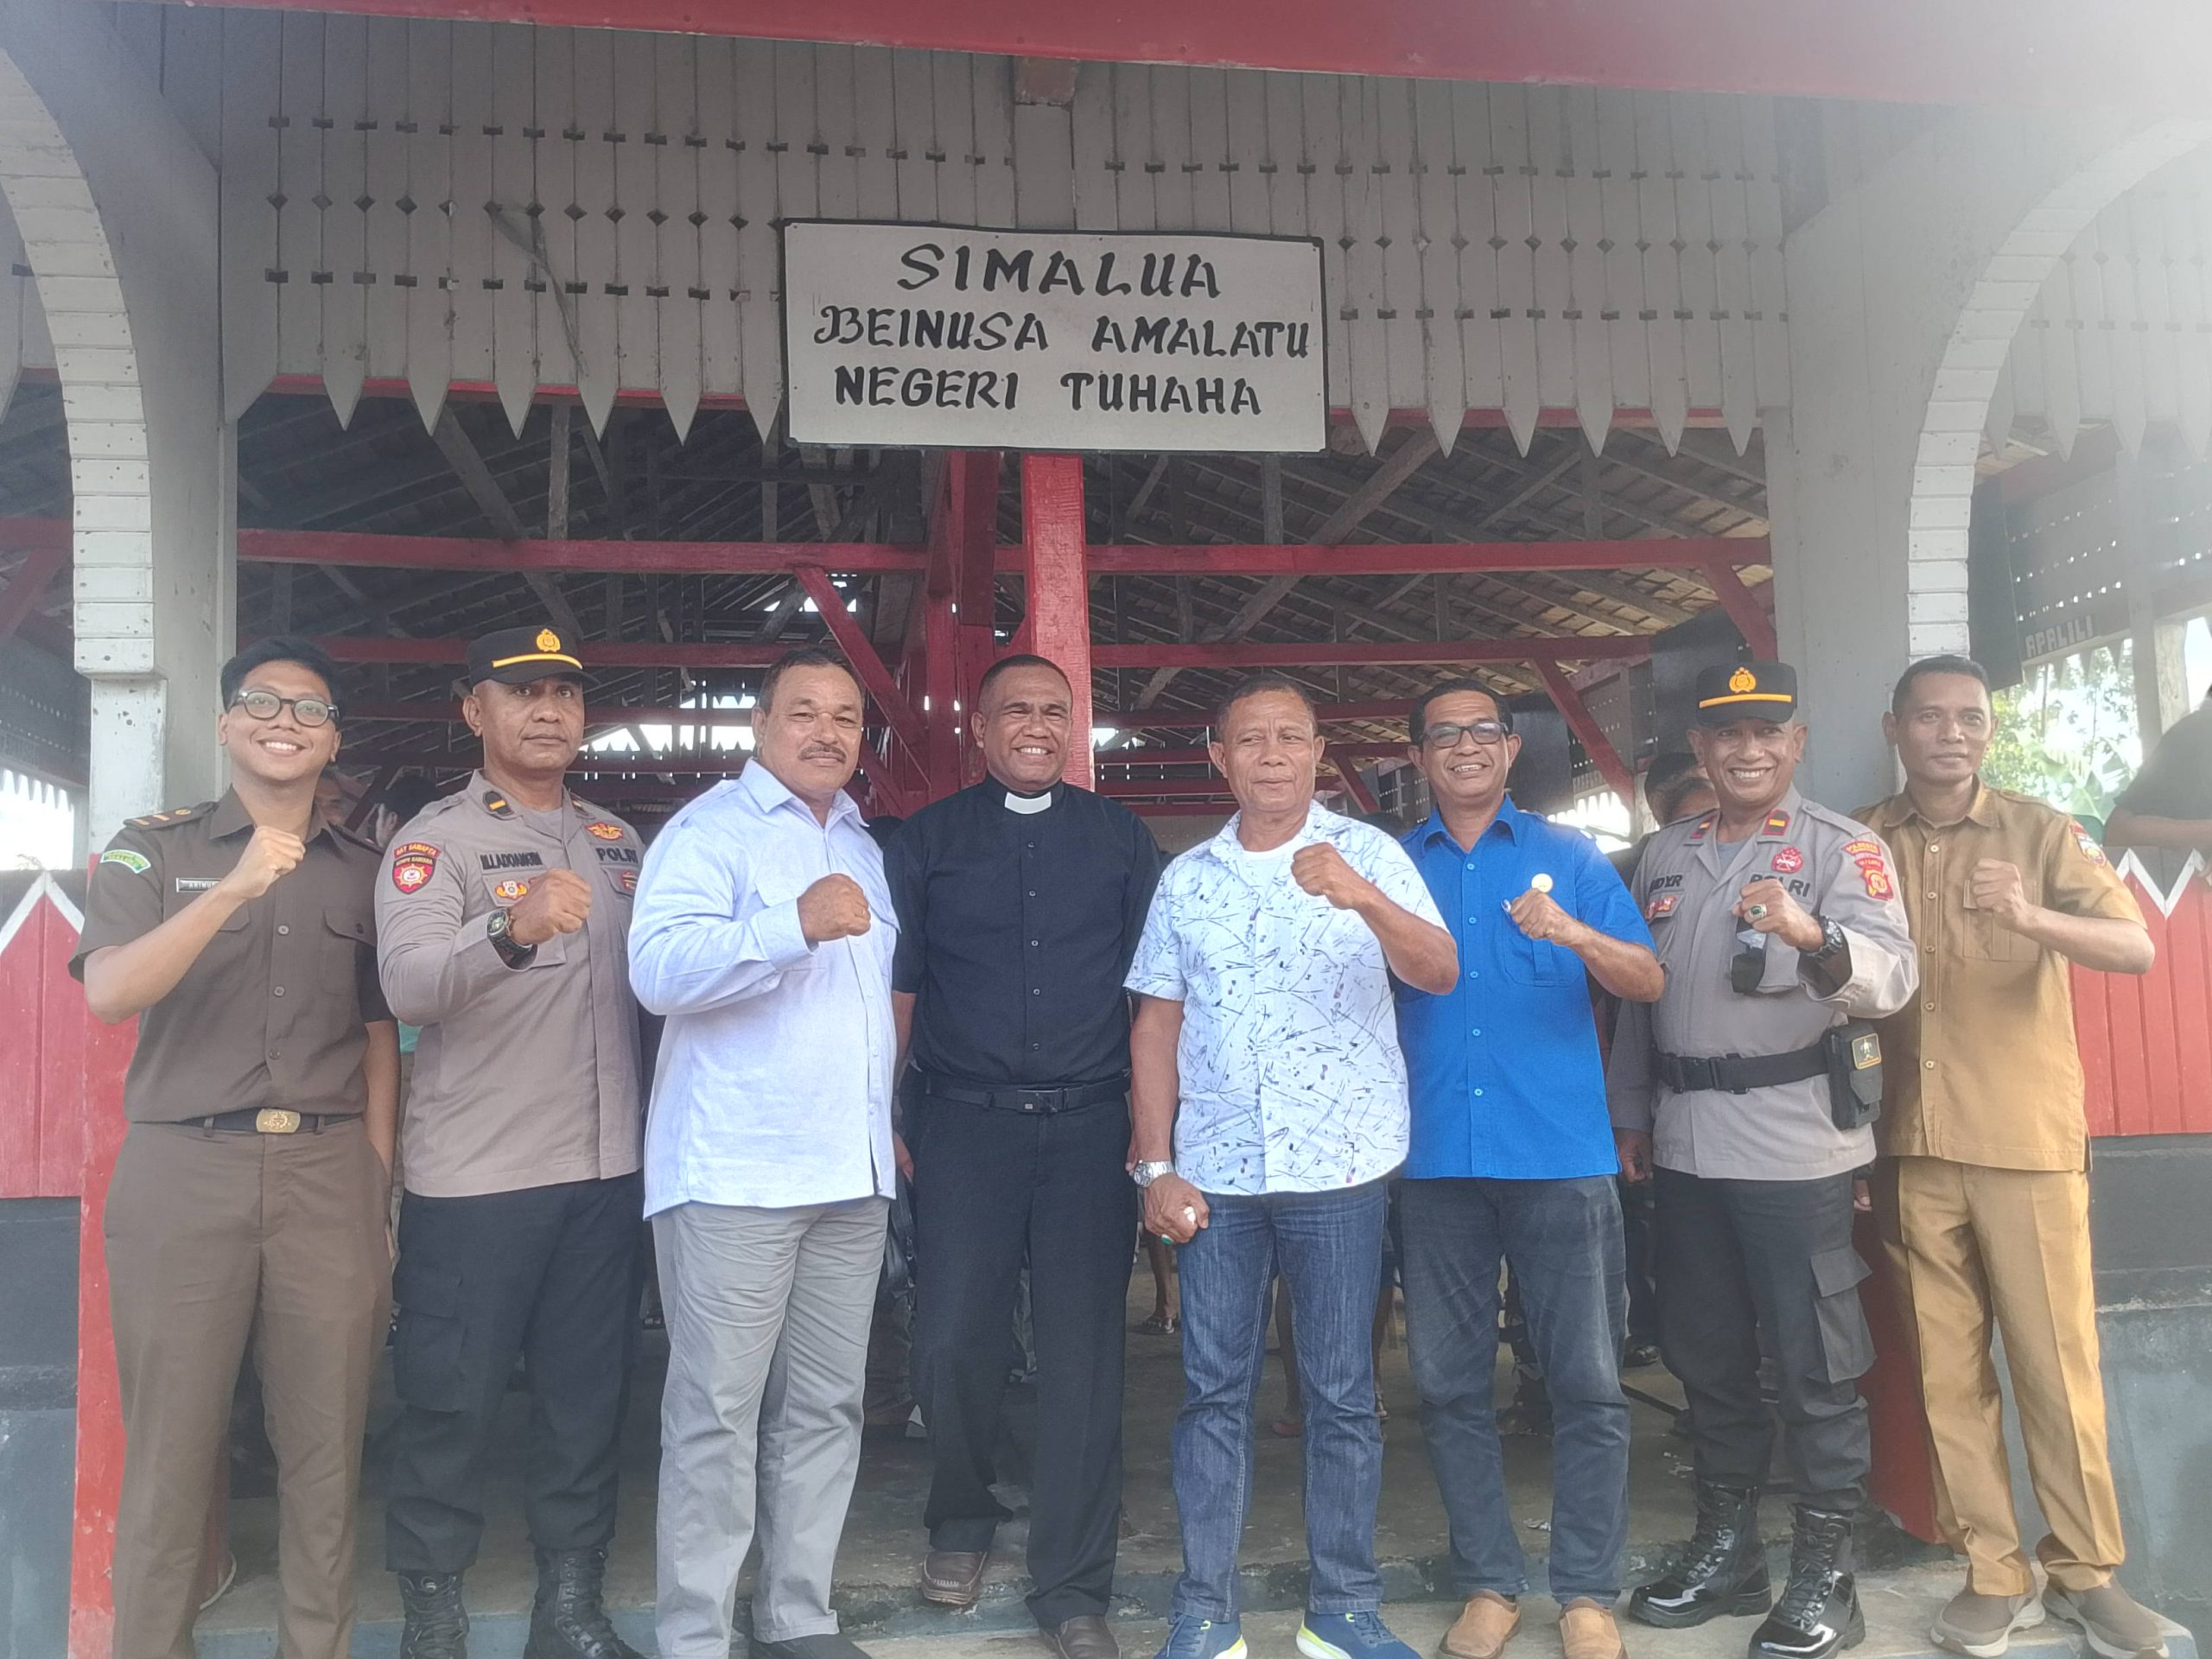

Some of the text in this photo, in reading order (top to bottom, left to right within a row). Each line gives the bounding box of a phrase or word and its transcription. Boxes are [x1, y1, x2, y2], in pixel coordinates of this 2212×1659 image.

[897, 243, 1221, 299] SIMALUA
[813, 305, 1309, 359] BEINUSA AMALATU
[834, 365, 1262, 415] NEGERI TUHAHA
[595, 848, 639, 864] POLRI
[1749, 874, 1811, 897] PRI
